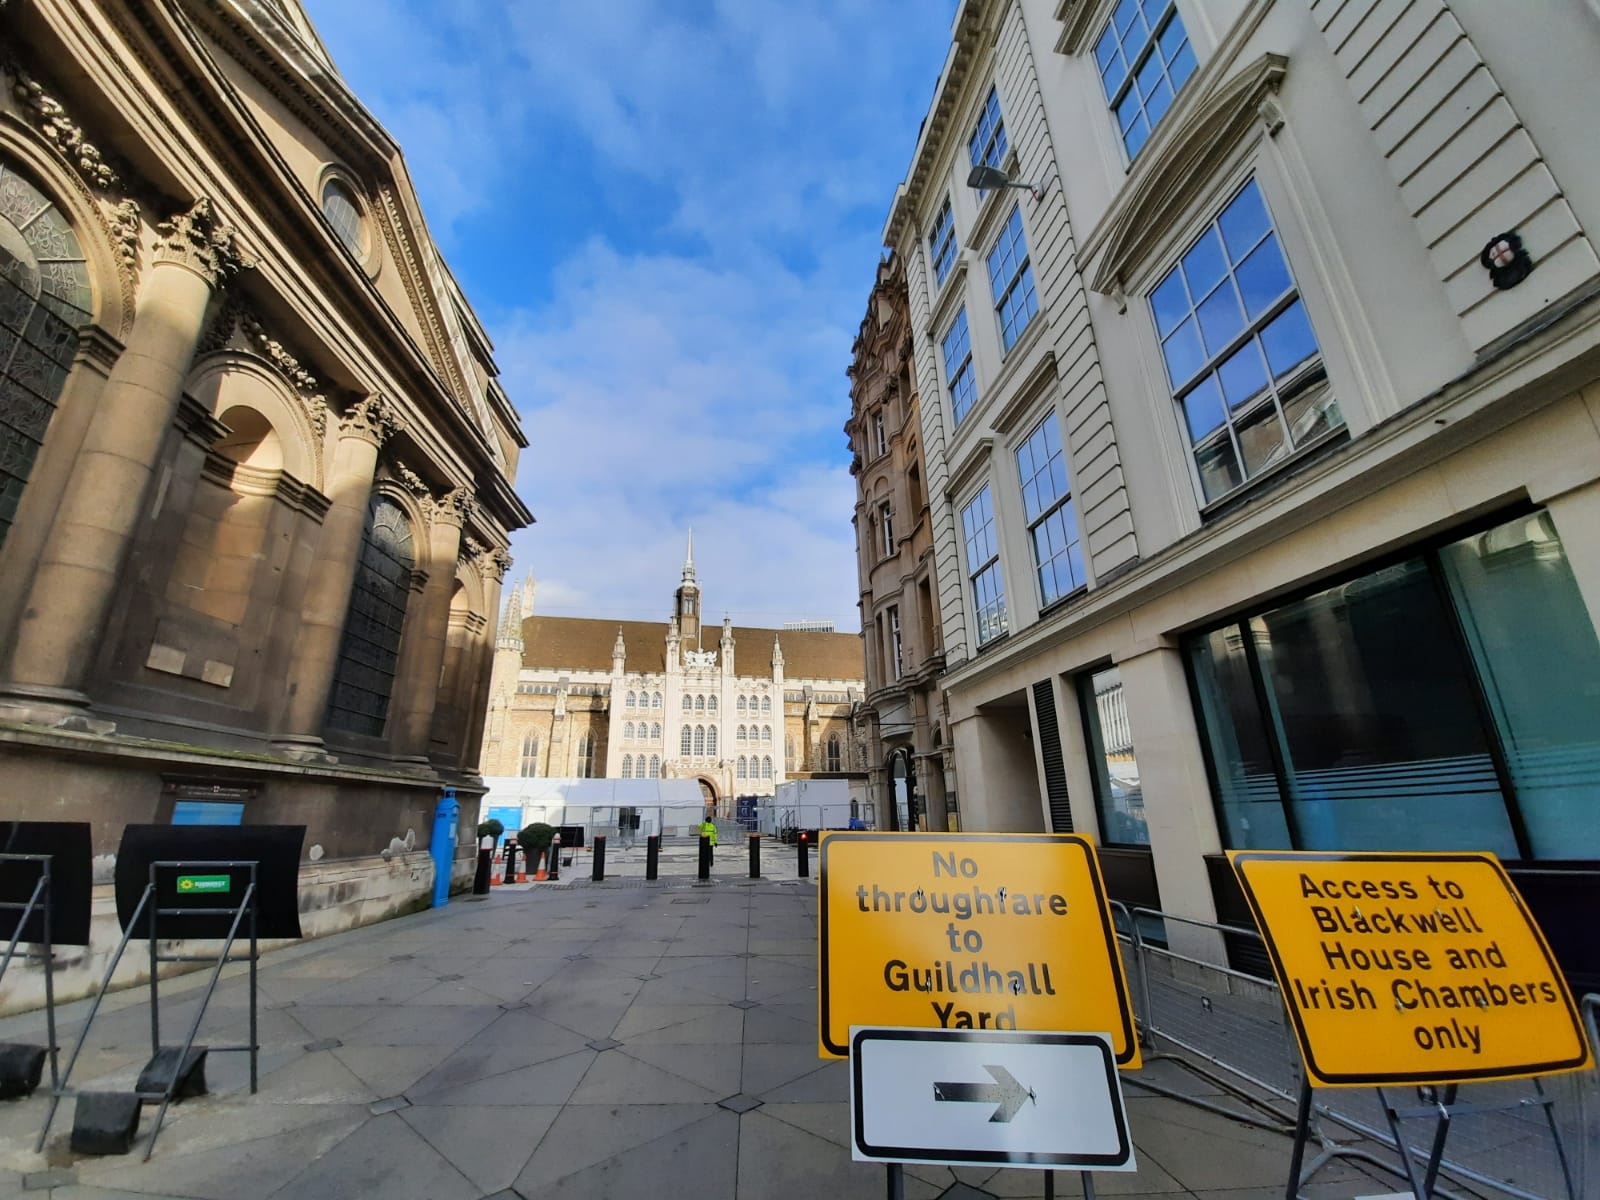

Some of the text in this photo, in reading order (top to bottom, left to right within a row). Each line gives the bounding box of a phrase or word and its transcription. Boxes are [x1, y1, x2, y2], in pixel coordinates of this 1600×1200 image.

[932, 851, 978, 879] No
[1300, 873, 1465, 899] Access to
[856, 884, 1068, 920] throughfare
[1311, 906, 1483, 934] Blackwell
[946, 922, 983, 953] to
[1320, 942, 1508, 970] House and
[884, 960, 1056, 995] Guildhall
[1294, 978, 1557, 1010] Irish Chambers
[931, 1002, 1016, 1030] Yard
[1414, 1018, 1482, 1054] only
